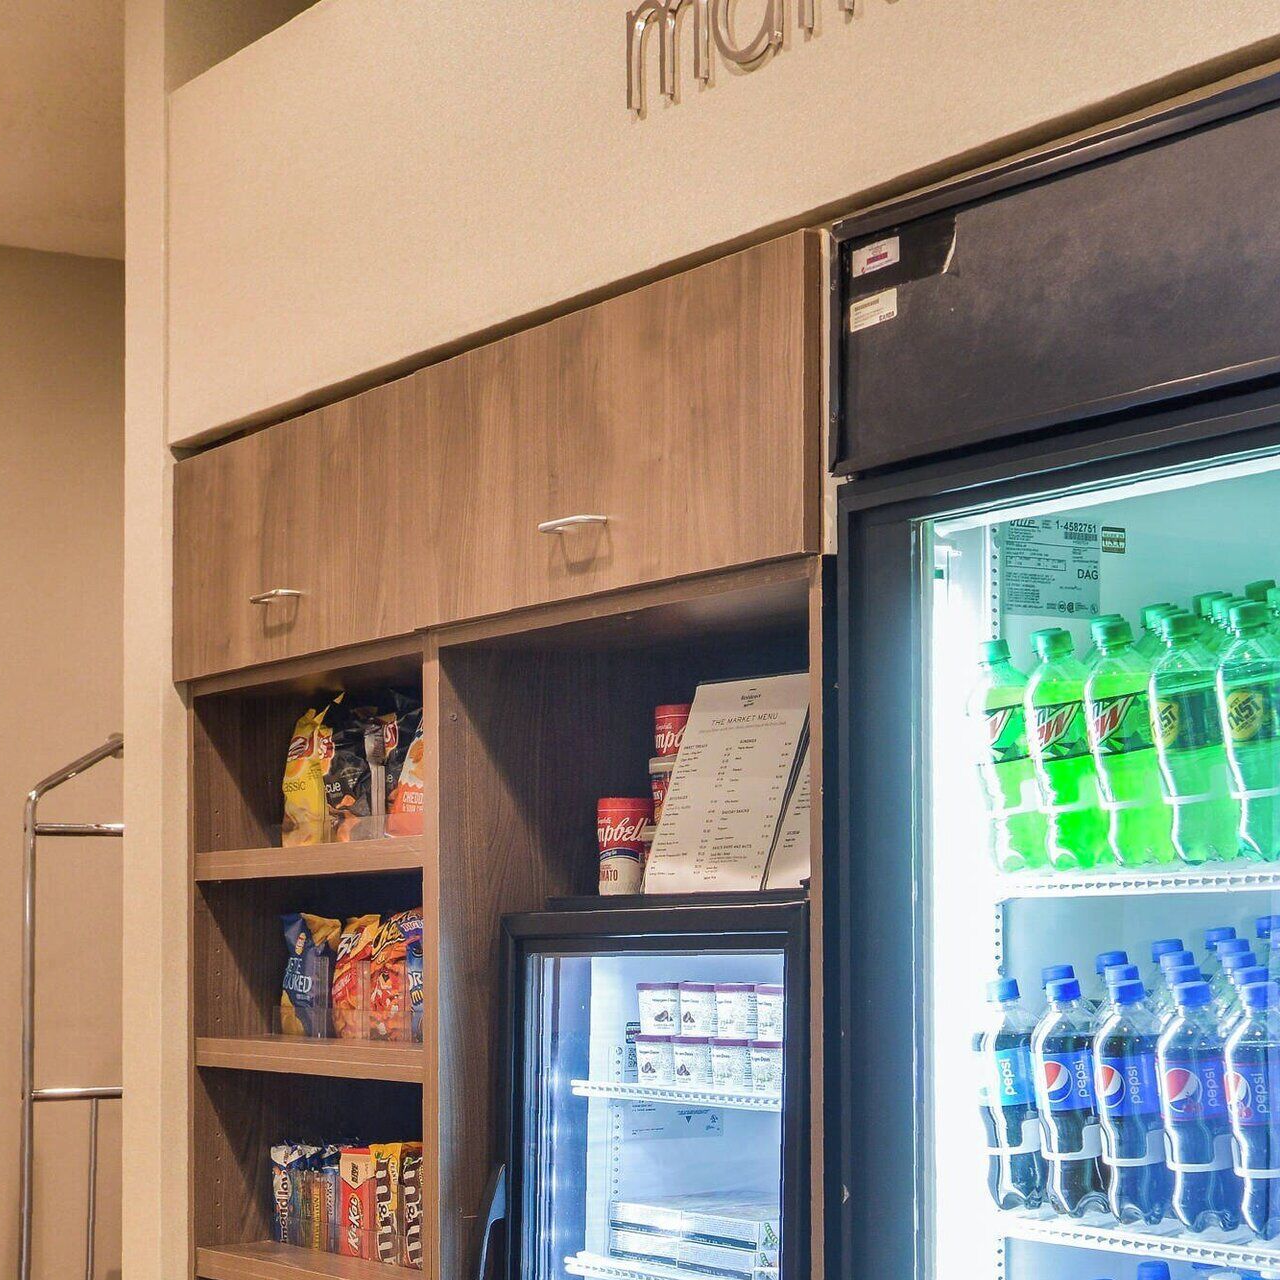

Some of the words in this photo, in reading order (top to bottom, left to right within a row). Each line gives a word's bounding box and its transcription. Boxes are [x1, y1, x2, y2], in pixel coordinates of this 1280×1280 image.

[1055, 519, 1097, 534] 1-4582751
[1077, 569, 1099, 580] DAG
[727, 715, 756, 724] MARKET
[758, 712, 779, 721] MENU
[999, 1058, 1018, 1096] pepsi
[1073, 1060, 1090, 1098] pepsi
[1125, 1066, 1144, 1104] pepsi
[1203, 1067, 1220, 1107] pepsi
[1251, 1073, 1269, 1114] pepsi
